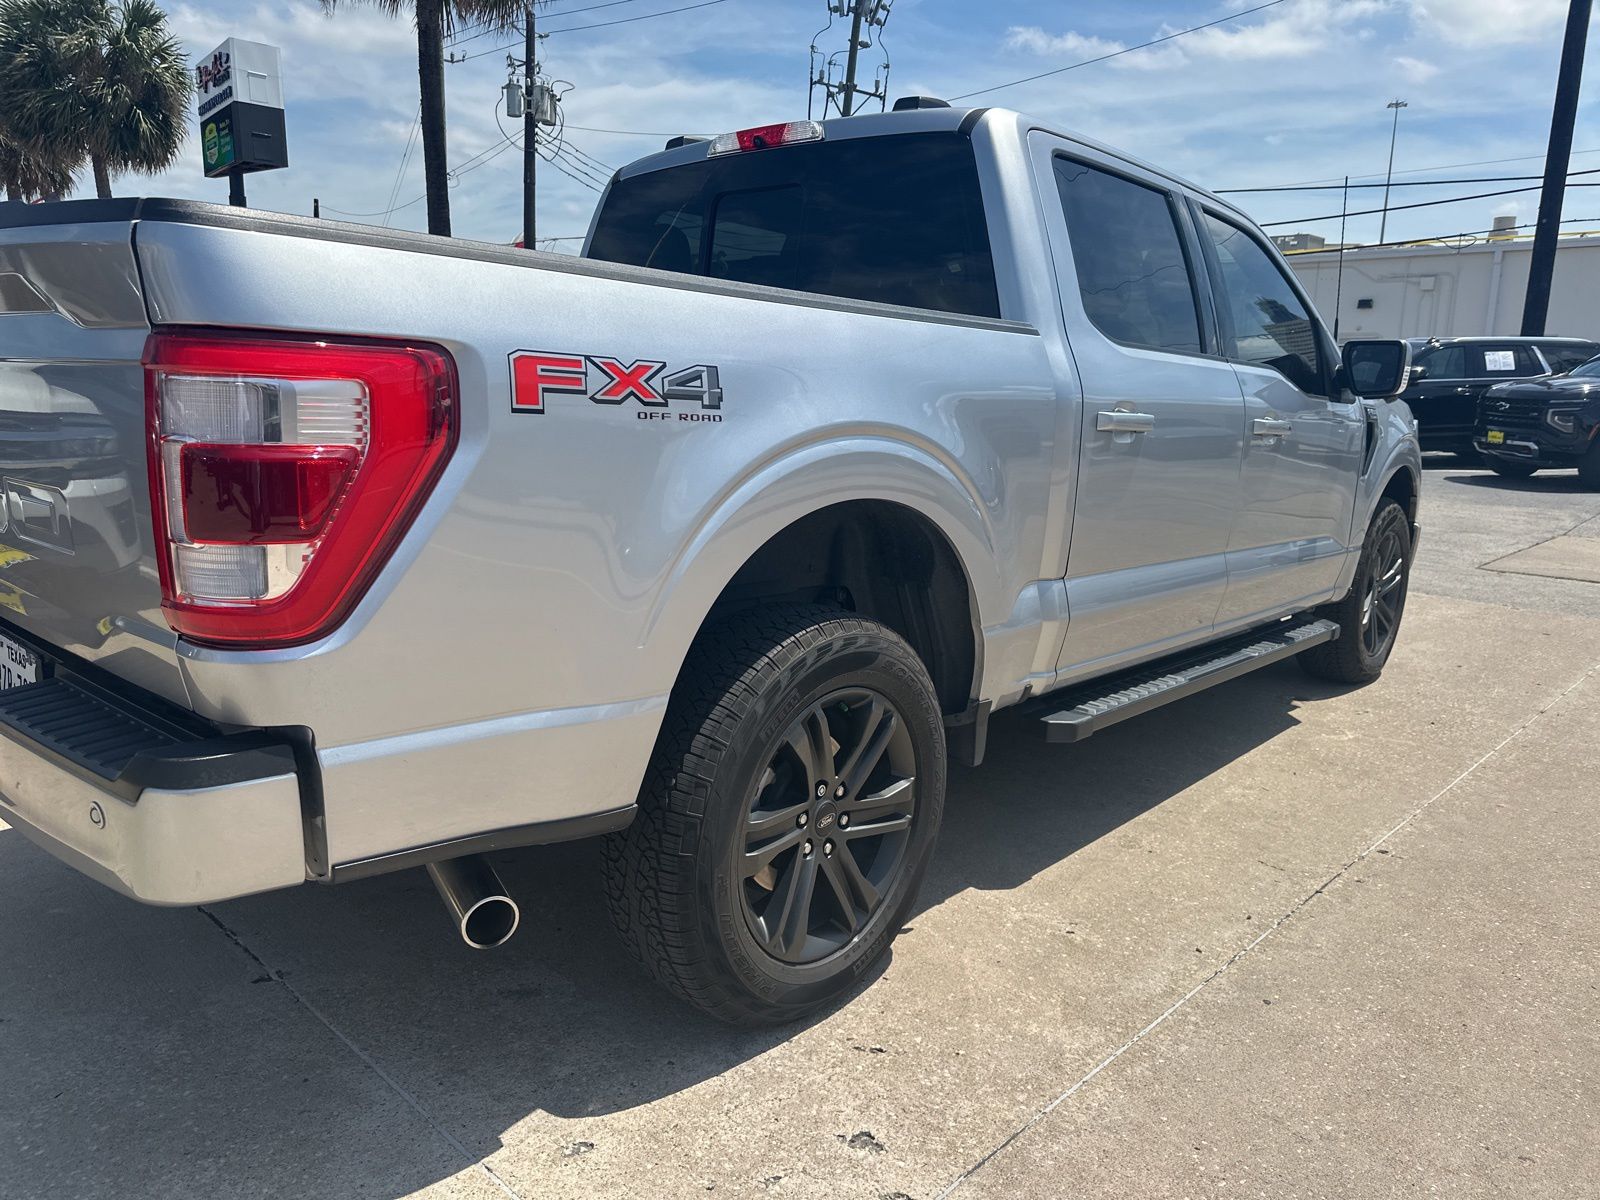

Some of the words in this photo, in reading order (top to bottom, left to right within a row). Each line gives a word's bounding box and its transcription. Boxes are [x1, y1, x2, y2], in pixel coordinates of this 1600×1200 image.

[507, 348, 724, 415] FX4
[637, 411, 671, 421] OFF
[678, 412, 723, 423] ROAD
[7, 644, 27, 670] TEXAS
